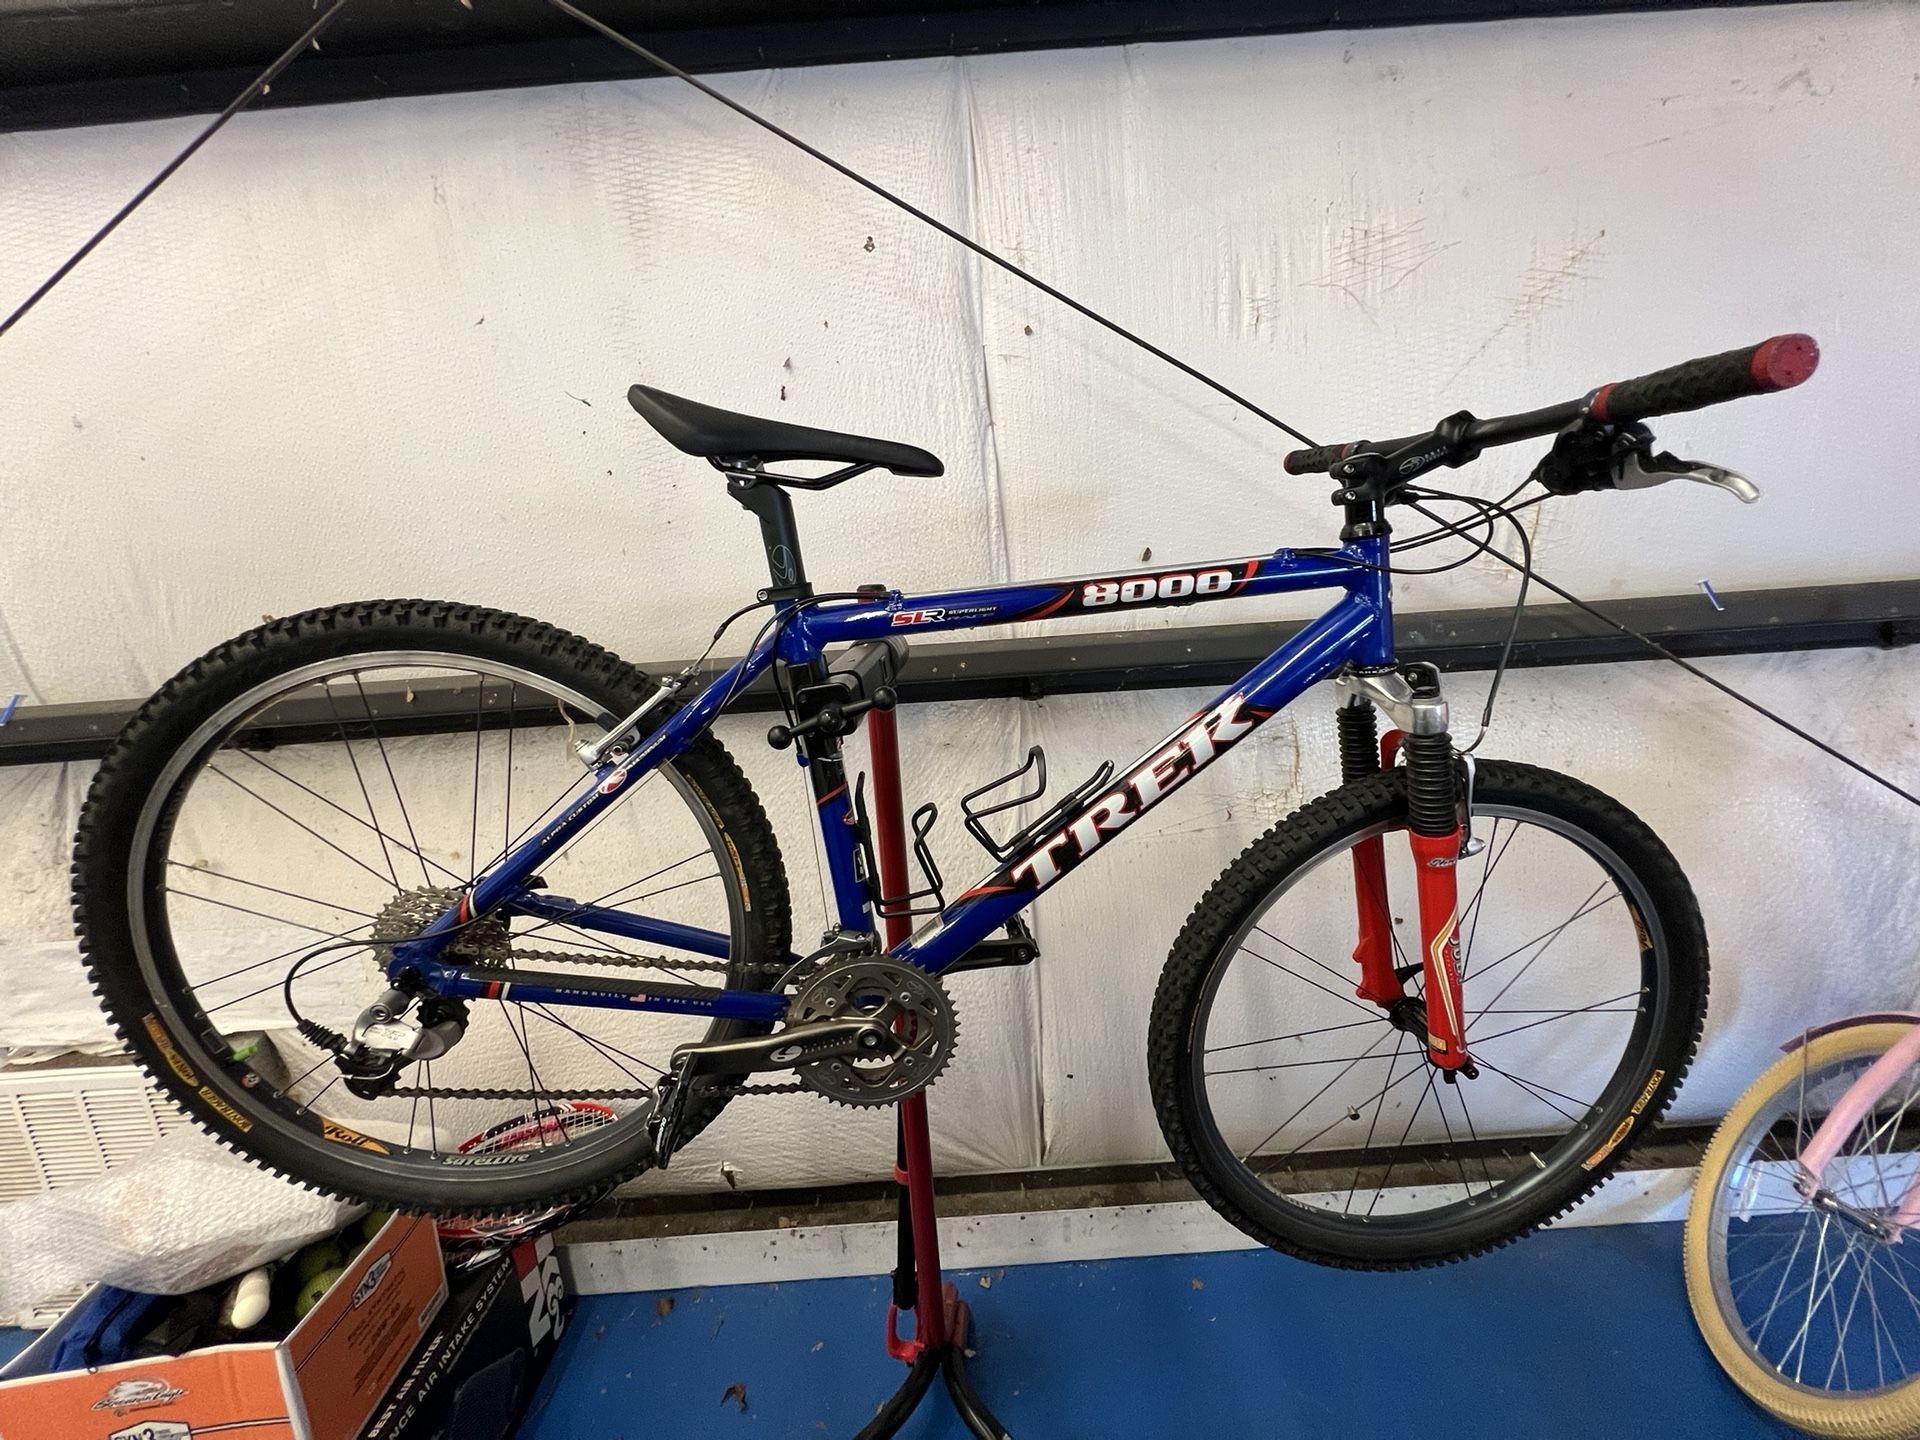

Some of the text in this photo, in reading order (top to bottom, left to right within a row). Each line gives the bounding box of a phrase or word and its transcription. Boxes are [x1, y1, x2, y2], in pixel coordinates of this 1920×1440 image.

[1083, 568, 1233, 607] 8000
[891, 608, 946, 626] SLR
[1010, 691, 1254, 892] TREK
[541, 820, 567, 847] ALPHA
[568, 792, 600, 822] CUSTOM
[555, 987, 628, 999] HANDBUILT
[418, 1372, 438, 1402] AIR
[438, 1313, 475, 1369] INTAKE
[475, 1256, 511, 1311] SYSTEM
[368, 1403, 397, 1439] BEST
[396, 1377, 416, 1400] AIR
[411, 1332, 443, 1376] FILTER
